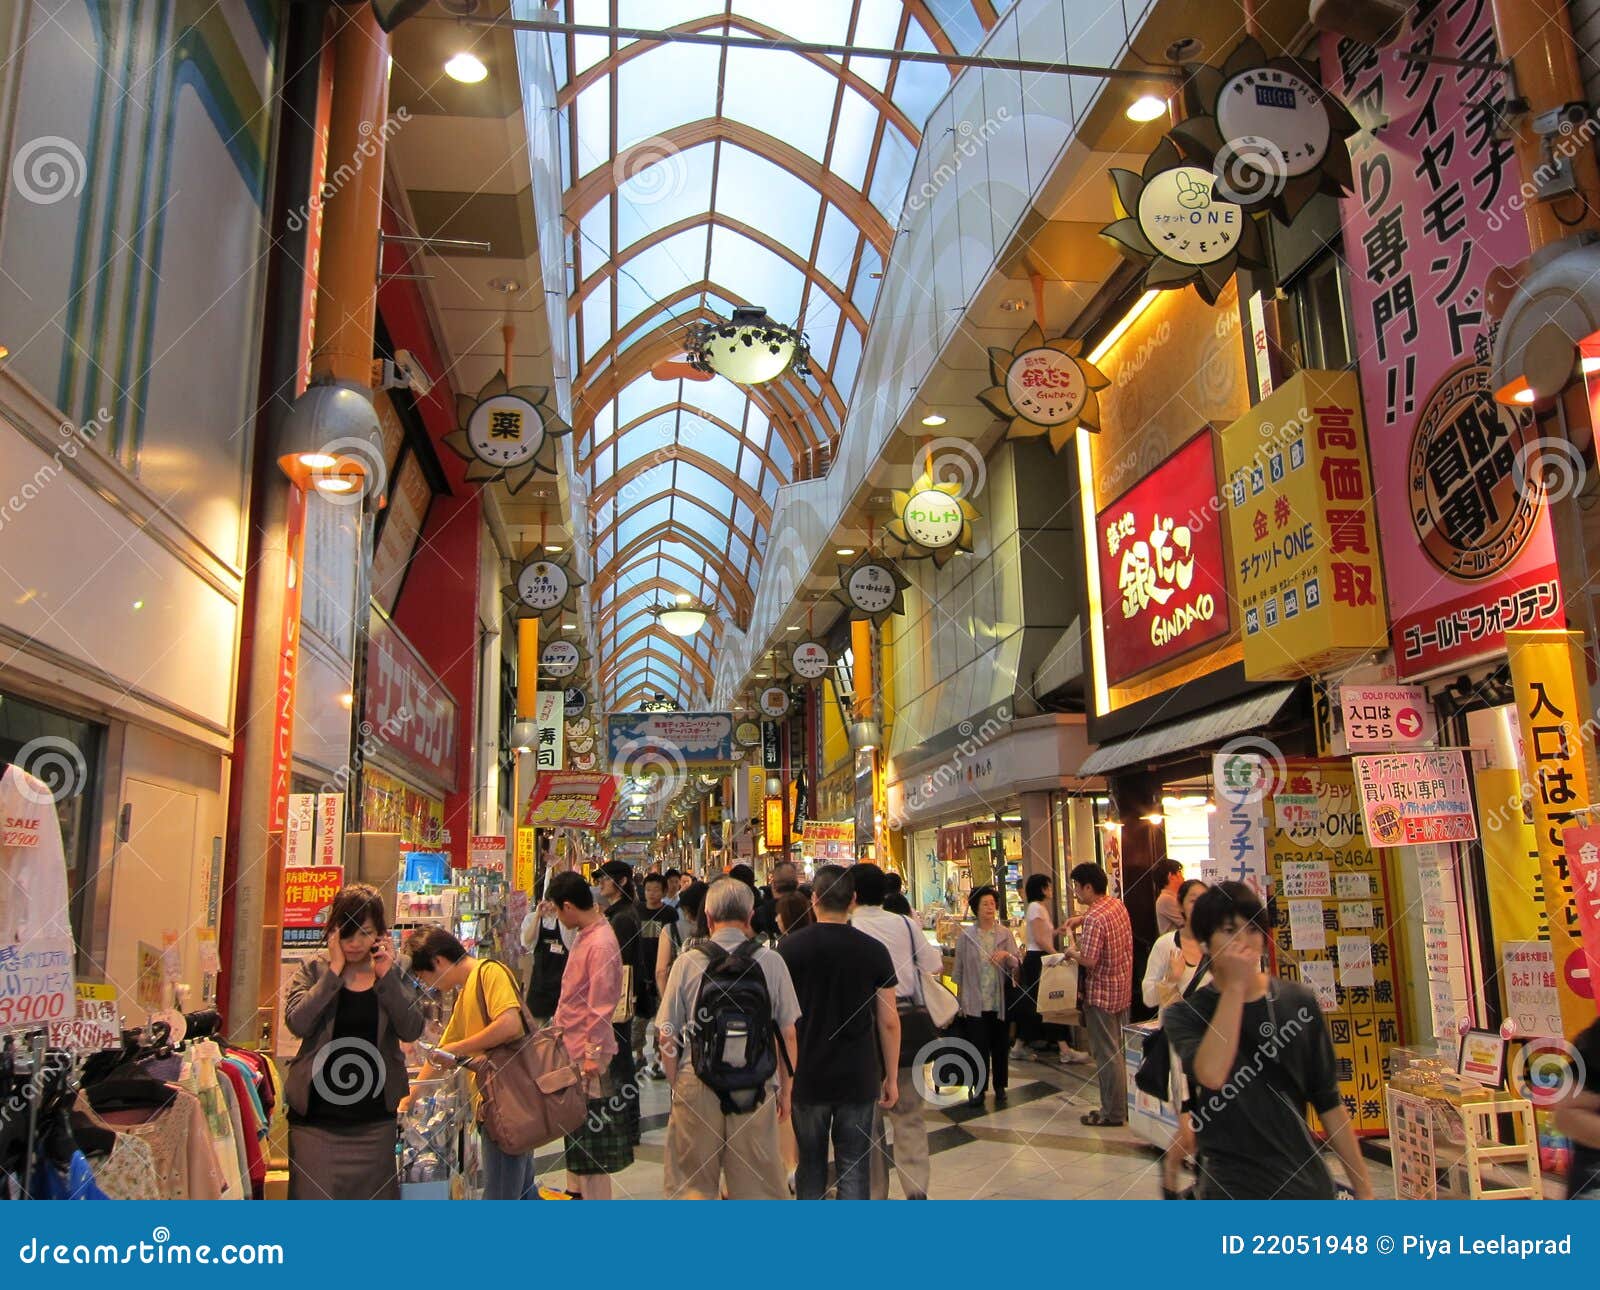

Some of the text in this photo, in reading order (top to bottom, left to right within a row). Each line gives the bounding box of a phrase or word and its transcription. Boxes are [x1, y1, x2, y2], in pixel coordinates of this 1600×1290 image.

[911, 509, 960, 524] わしや
[1252, 494, 1291, 542] 金券
[1313, 405, 1377, 608] 高価買取
[1118, 513, 1195, 620] 銀だこ
[1151, 594, 1215, 648] GINDACO
[1404, 580, 1561, 659] ゴールドフォンテン
[1350, 705, 1392, 720] 入口は
[1362, 691, 1422, 701] GOLD FOUNTAIN
[1352, 723, 1394, 739] こちら
[4, 817, 40, 830] SALE
[1355, 1019, 1382, 1120] ビール券
